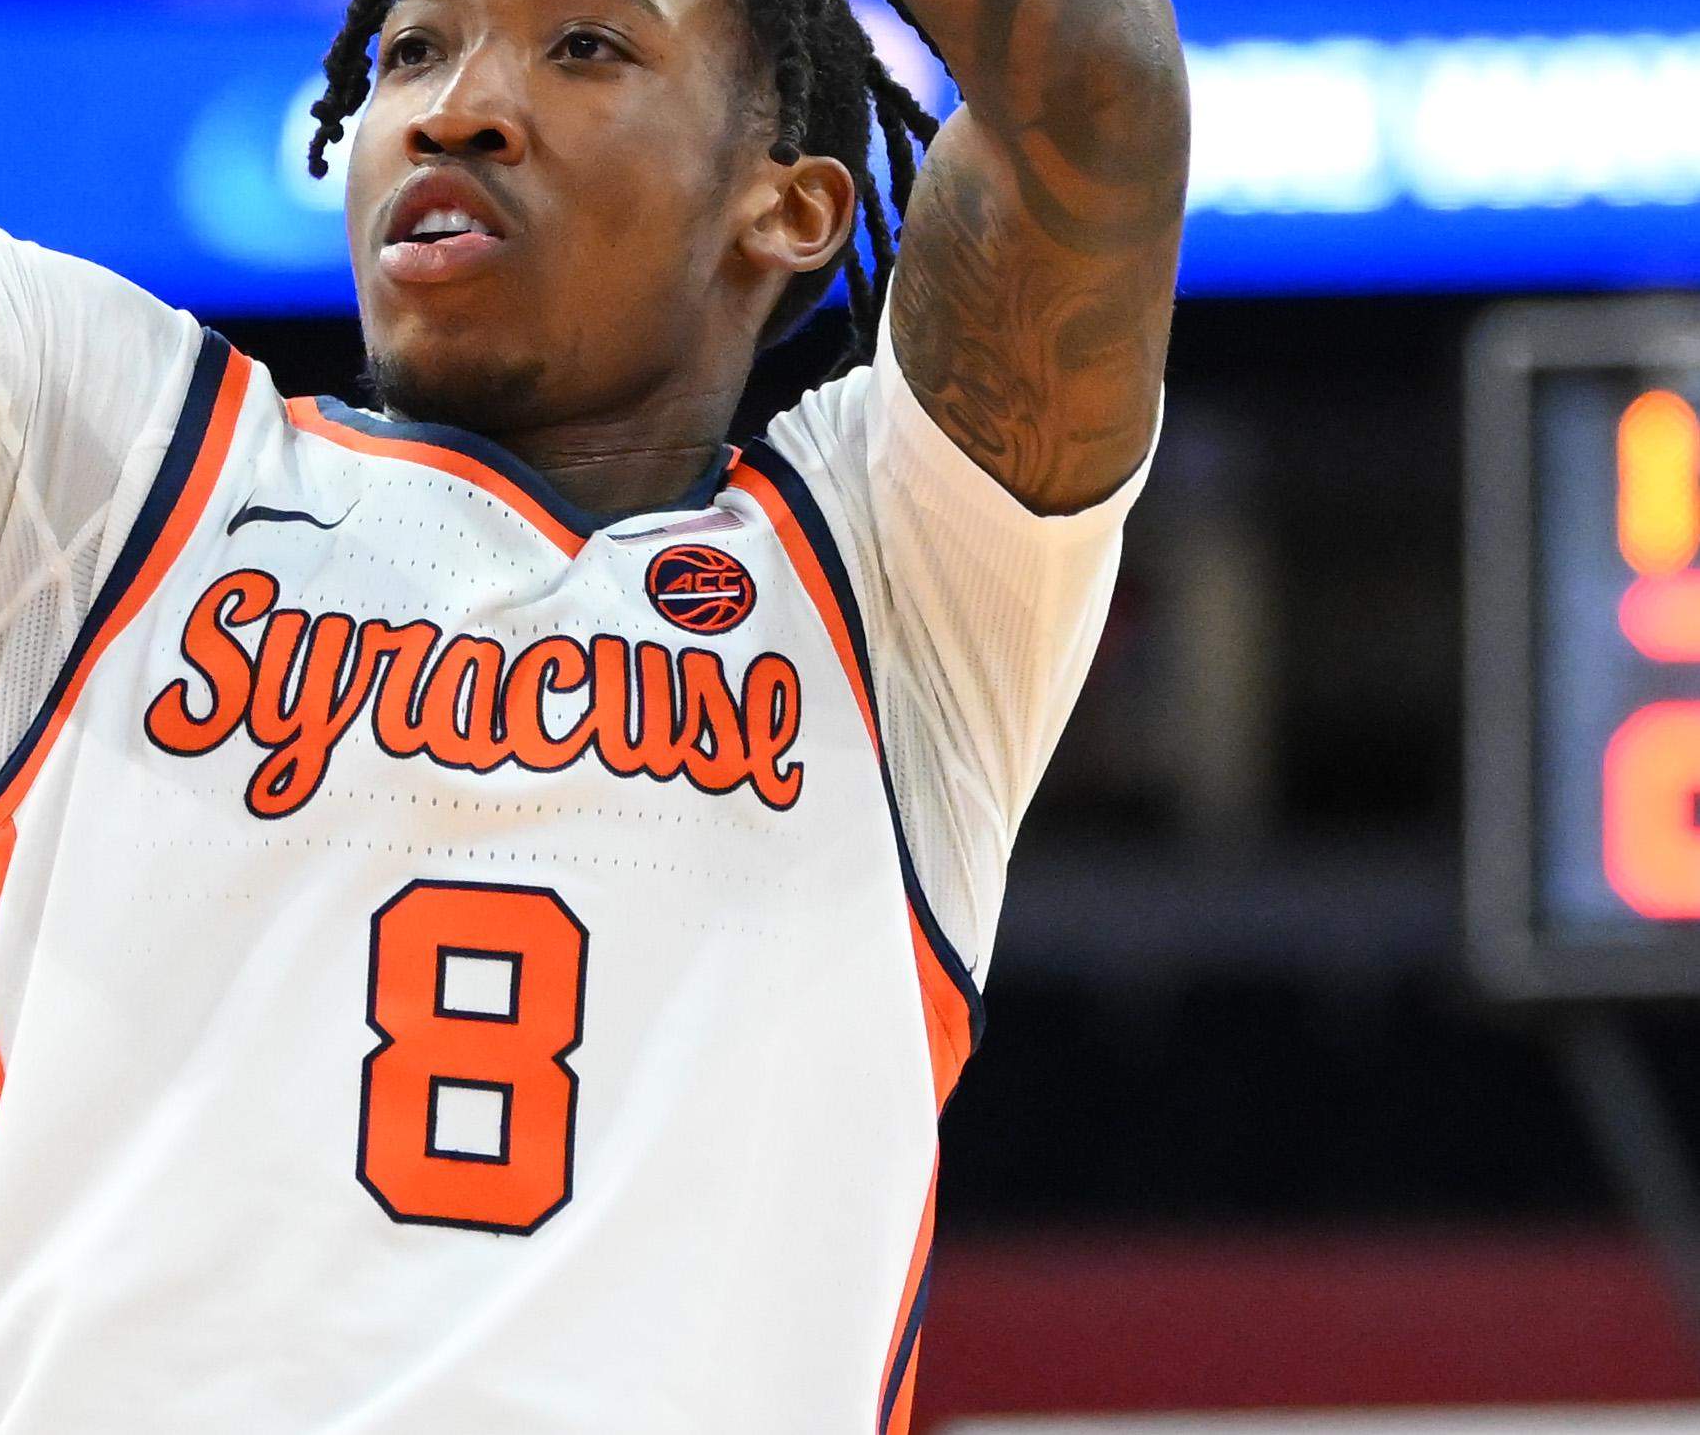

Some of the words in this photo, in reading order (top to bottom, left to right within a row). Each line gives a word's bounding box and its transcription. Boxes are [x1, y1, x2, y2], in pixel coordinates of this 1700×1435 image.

[144, 568, 804, 819] Syracuse
[664, 571, 743, 592] ACC
[356, 878, 590, 1237] 8
